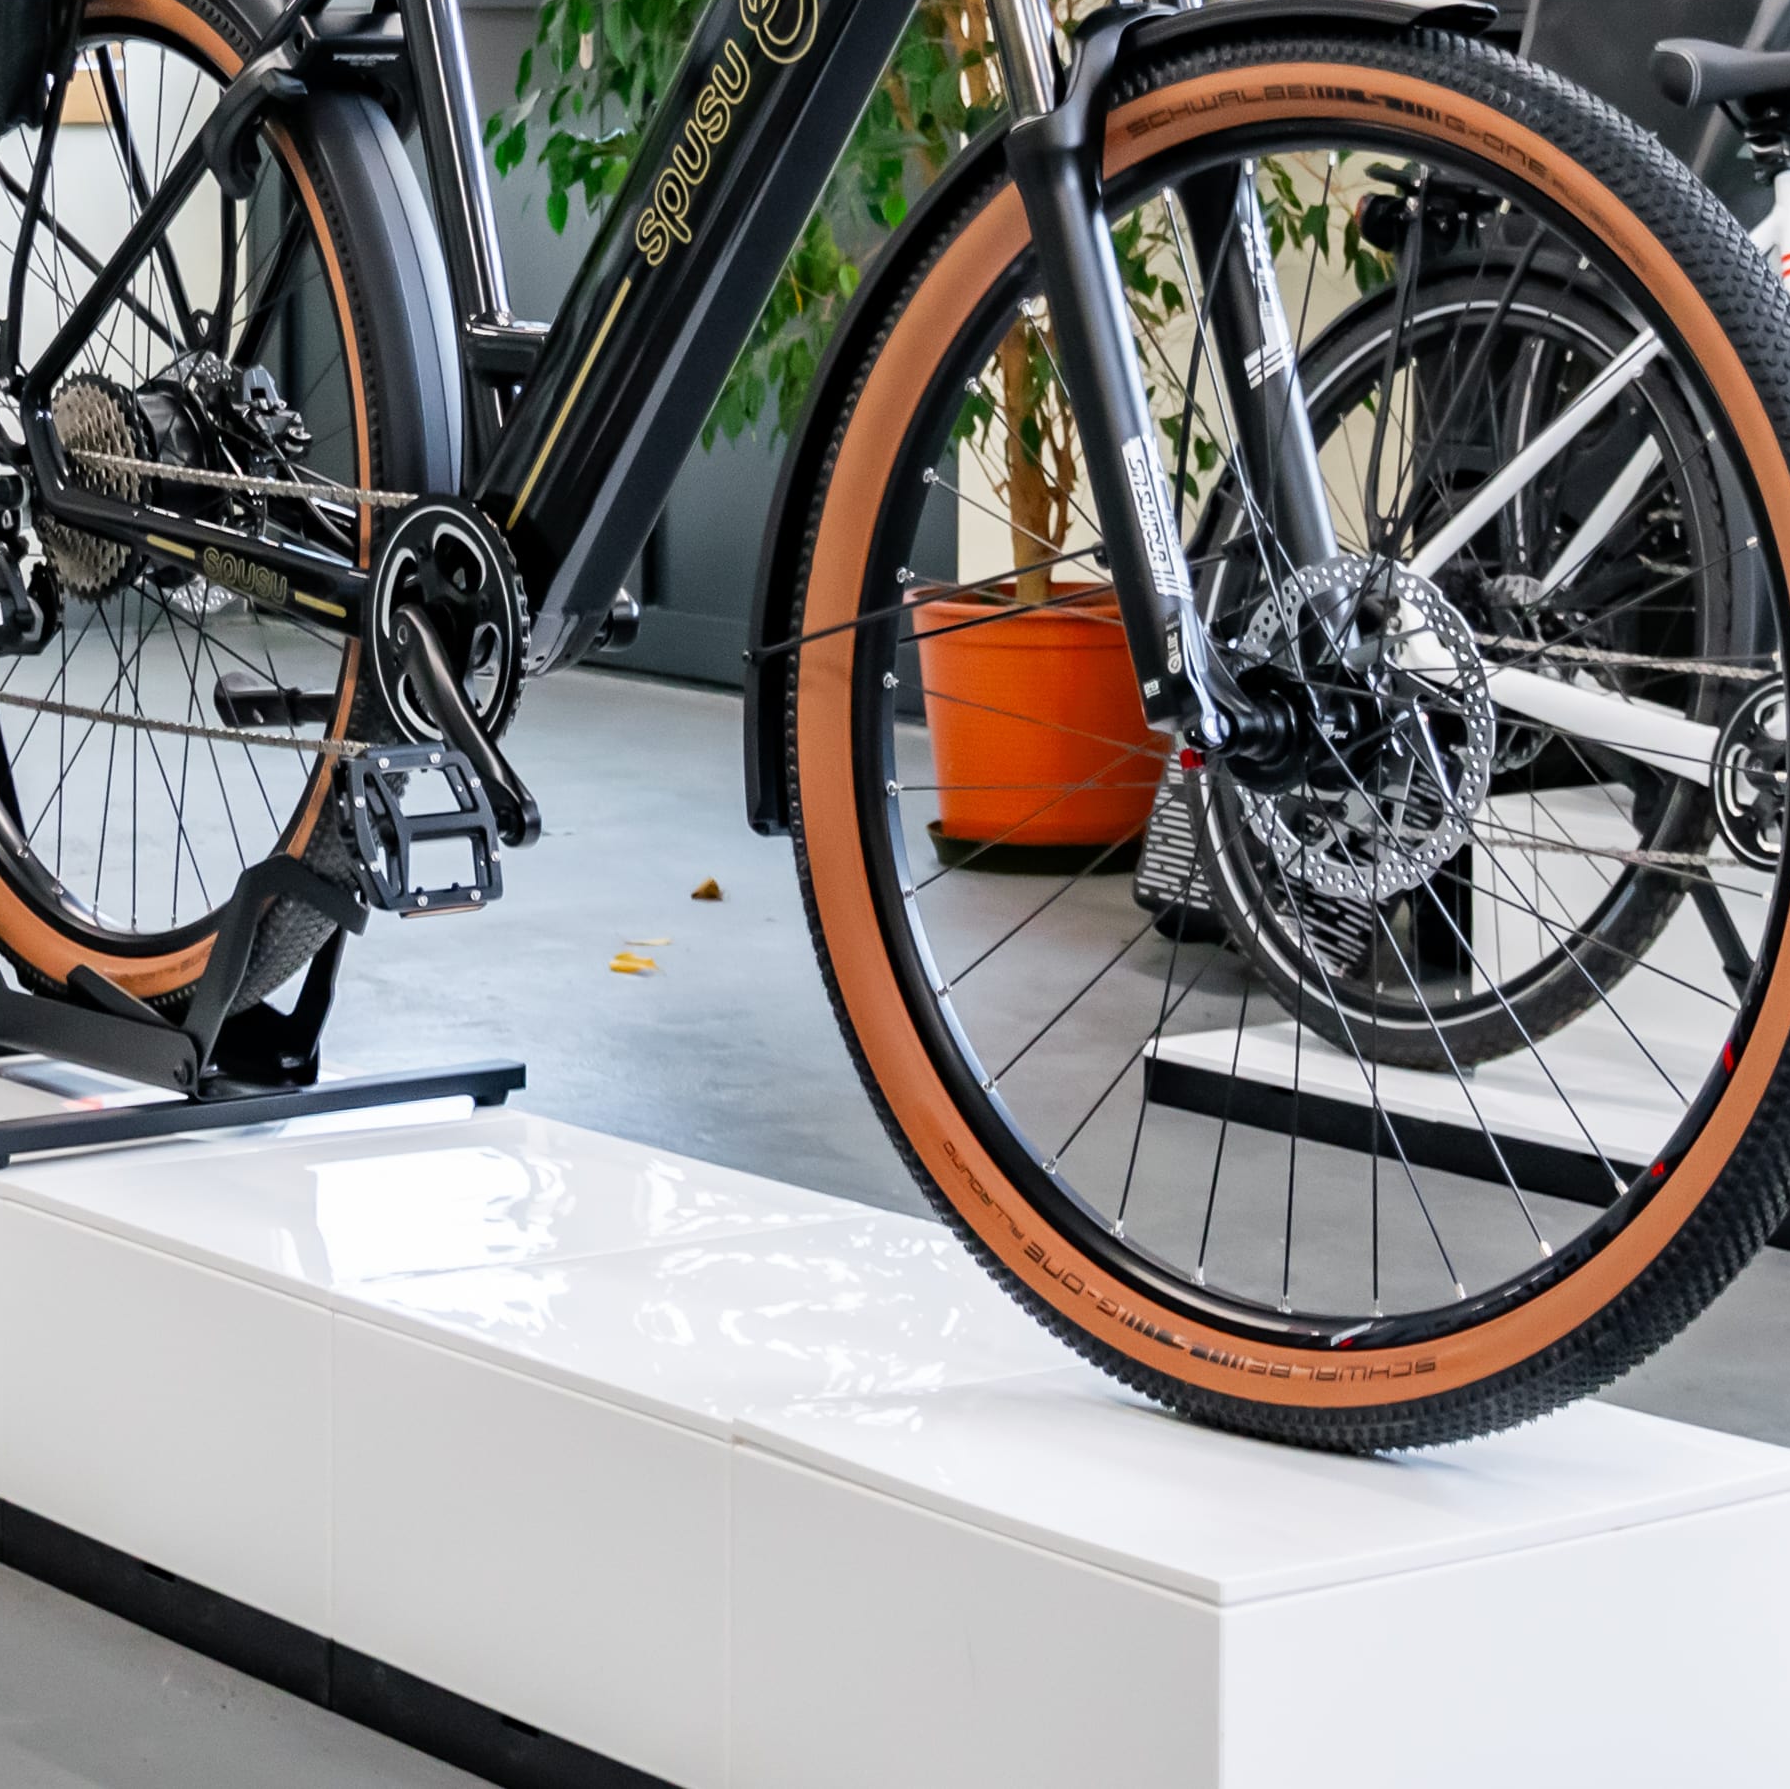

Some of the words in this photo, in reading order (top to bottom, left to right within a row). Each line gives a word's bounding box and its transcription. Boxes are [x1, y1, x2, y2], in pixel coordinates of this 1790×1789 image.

[1125, 83, 1308, 139] SCHWALBE
[635, 39, 751, 267] spusu
[942, 1140, 1025, 1241] ALLROUND
[1023, 1241, 1120, 1318] G-ONE
[1248, 1356, 1436, 1383] SCHWALBE
